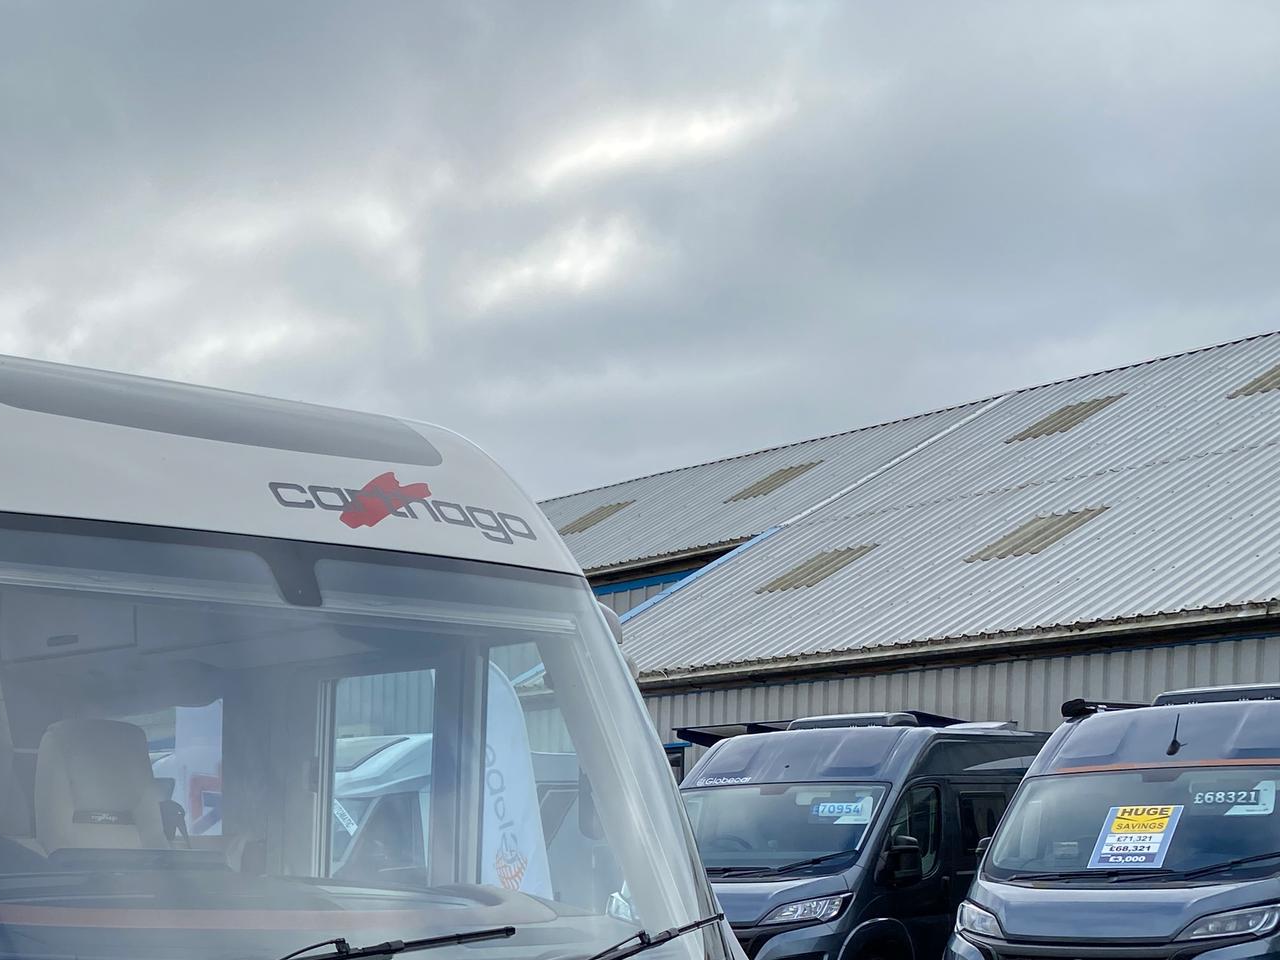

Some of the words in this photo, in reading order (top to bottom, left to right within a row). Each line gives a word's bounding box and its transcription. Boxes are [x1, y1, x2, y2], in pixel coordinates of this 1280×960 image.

[1193, 791, 1257, 804] £68321
[1120, 807, 1171, 817] HUGE
[1116, 822, 1165, 830] SAVINGS
[1109, 855, 1146, 863] £3,000
